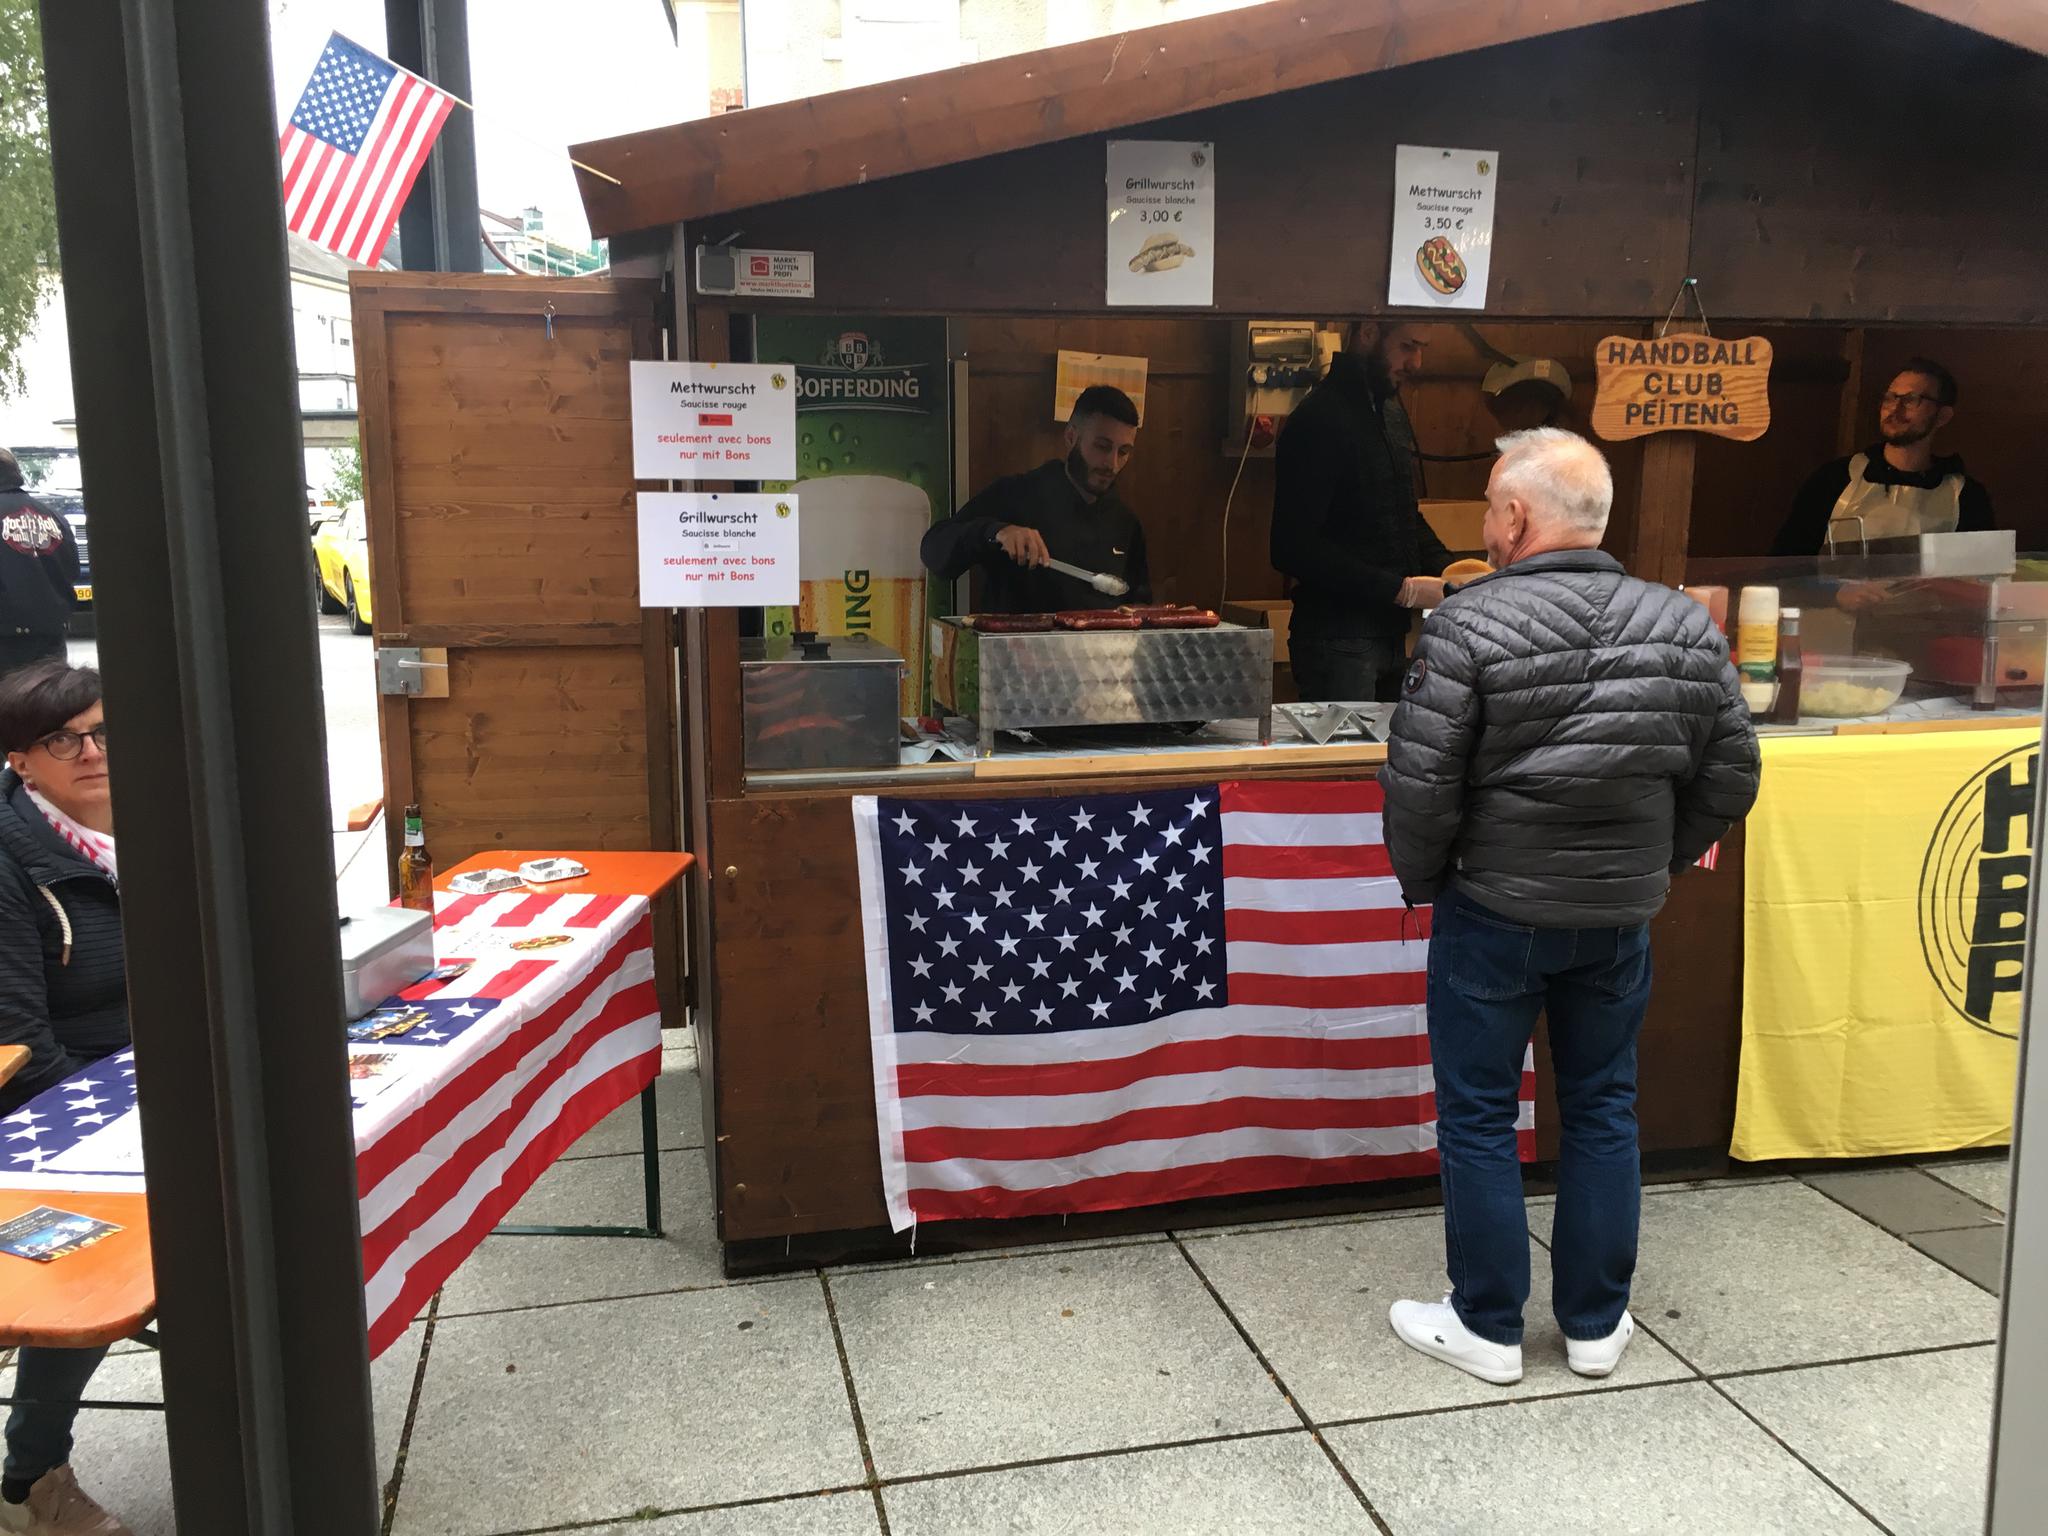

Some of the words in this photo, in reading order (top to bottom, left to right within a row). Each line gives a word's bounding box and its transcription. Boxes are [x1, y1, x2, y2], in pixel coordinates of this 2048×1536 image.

[1125, 177, 1195, 190] Grillwurscht
[1409, 184, 1482, 200] Mettwurscht
[1126, 195, 1161, 204] Saucisse
[1165, 195, 1196, 204] blanche
[1416, 202, 1449, 212] Saucisse
[1452, 205, 1473, 216] rouge
[1140, 210, 1169, 224] 3,00
[1424, 216, 1452, 231] 3,50
[1608, 342, 1757, 366] HANDBALL
[670, 381, 756, 395] Mettwurscht
[795, 375, 919, 398] BOFFERDING
[1643, 372, 1723, 396] CLUB
[680, 400, 719, 409] Saucisse
[722, 401, 748, 411] rouge
[657, 433, 713, 444] seulement
[718, 434, 742, 444] avec
[747, 433, 772, 445] bons
[680, 450, 698, 459] nur
[702, 449, 721, 460] mit
[725, 449, 751, 461] Bons
[679, 511, 758, 524] Grillwurscht
[682, 529, 720, 538] Saucisse
[723, 529, 757, 538] blanche
[663, 555, 718, 566] seulement
[722, 557, 747, 566] avec
[751, 555, 776, 566] bons
[685, 572, 703, 581] nur
[707, 571, 725, 581] mit
[730, 570, 755, 581] Bons
[845, 570, 871, 637] ING
